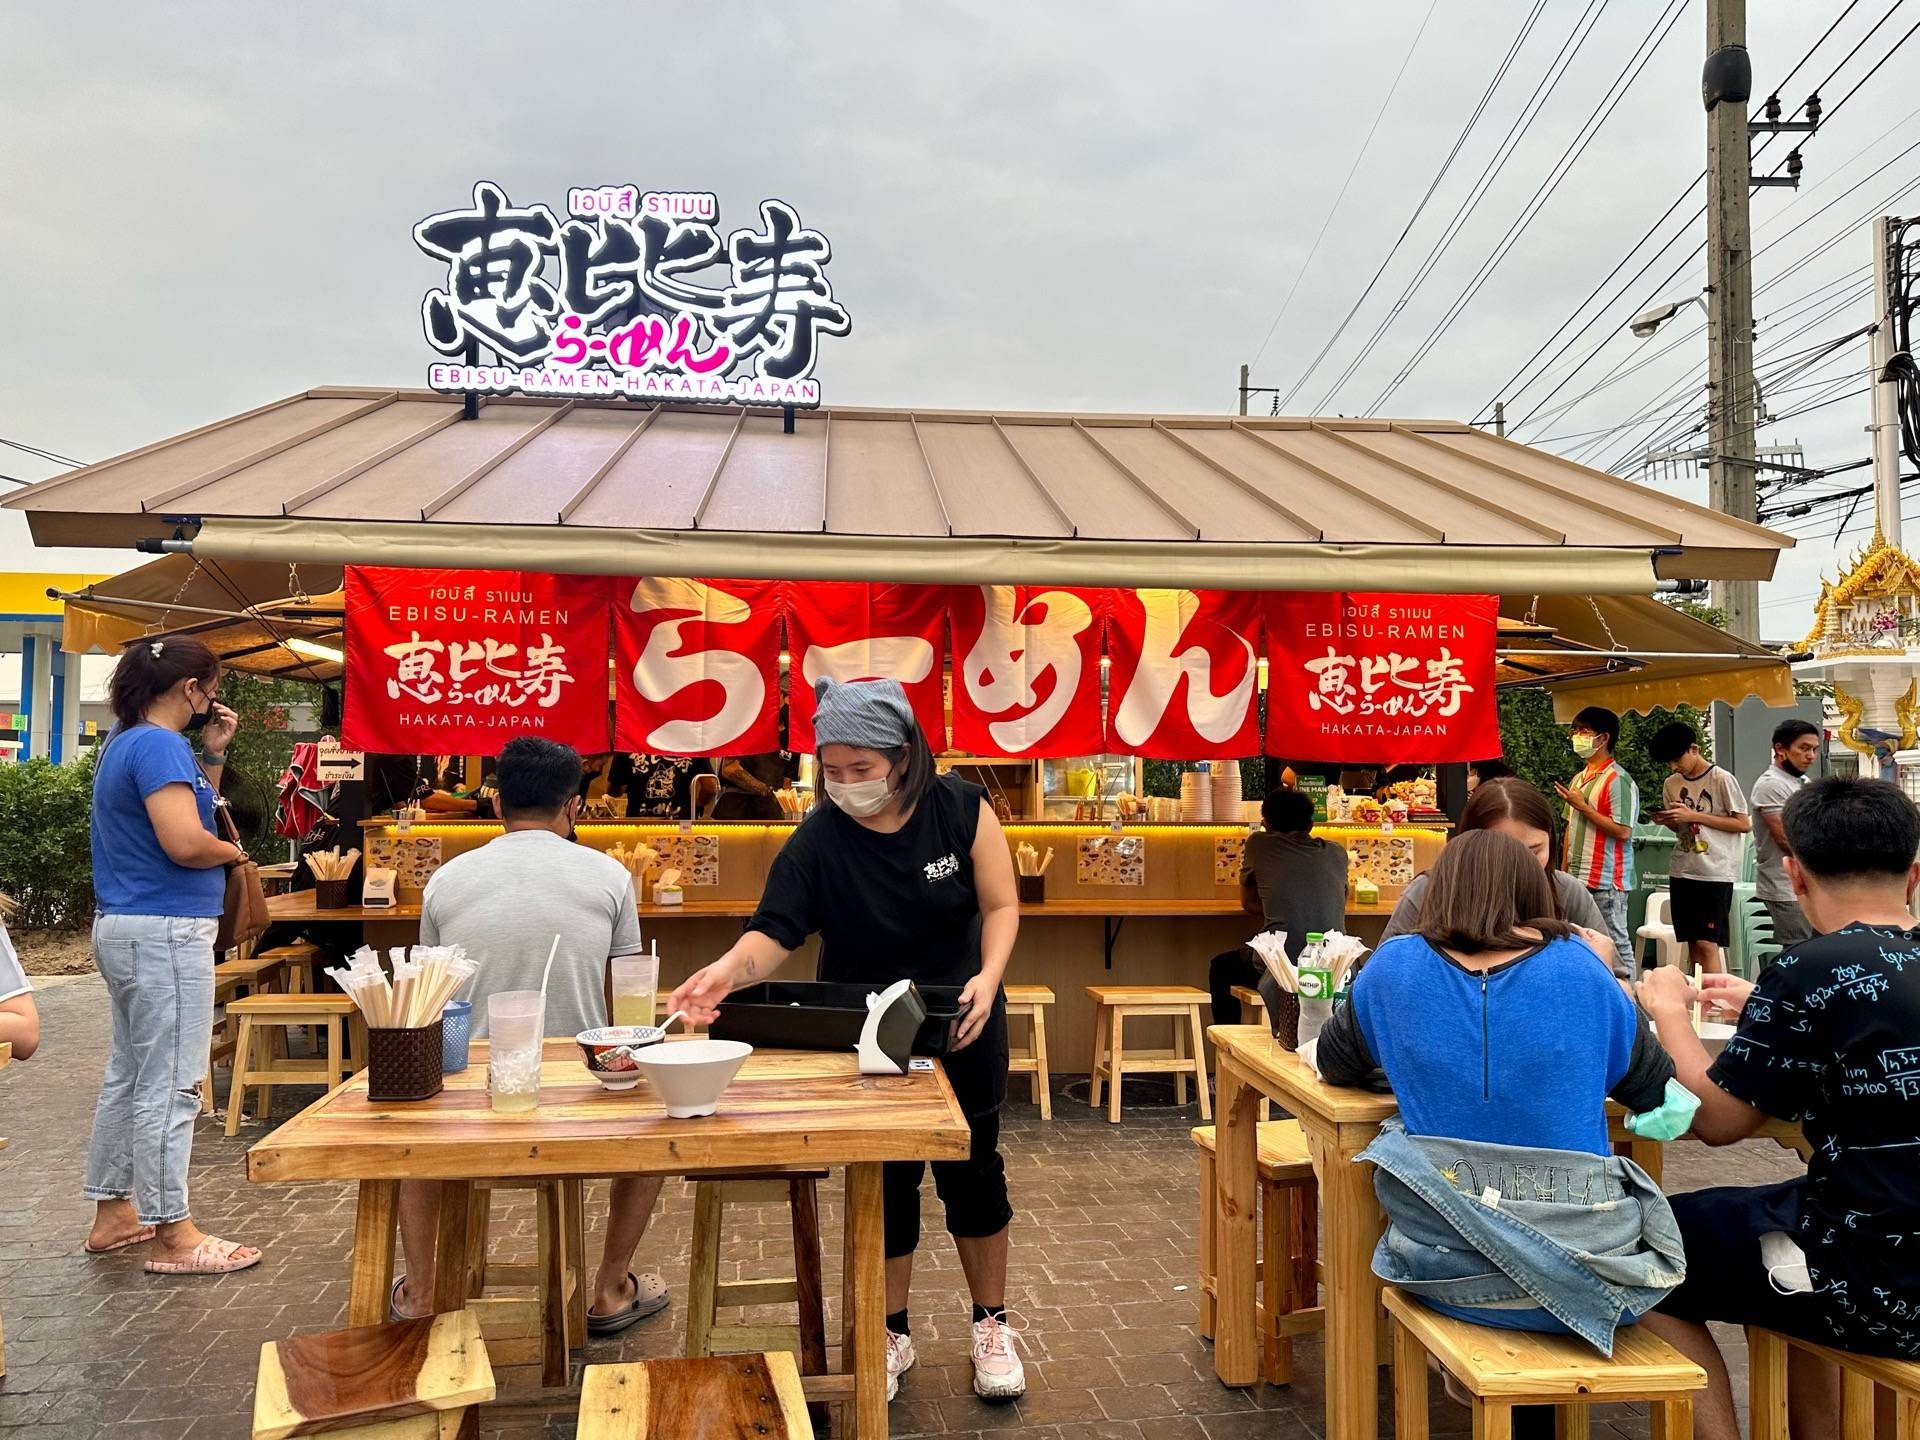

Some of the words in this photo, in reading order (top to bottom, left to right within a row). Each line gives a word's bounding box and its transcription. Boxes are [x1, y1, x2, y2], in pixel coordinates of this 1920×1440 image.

[648, 197, 711, 215] ราเมน
[552, 316, 730, 374] らーめん
[485, 590, 534, 603] ราเมน
[389, 606, 569, 625] EBISU-RAMEN
[1389, 607, 1432, 619] ราเมน
[1306, 623, 1465, 639] EBISU-RAMEN
[446, 682, 528, 706] らーめん
[1359, 693, 1428, 717] らーめん
[400, 713, 545, 728] HAKATA-JAPAN
[1321, 723, 1447, 736] HAKATA-JAPAN
